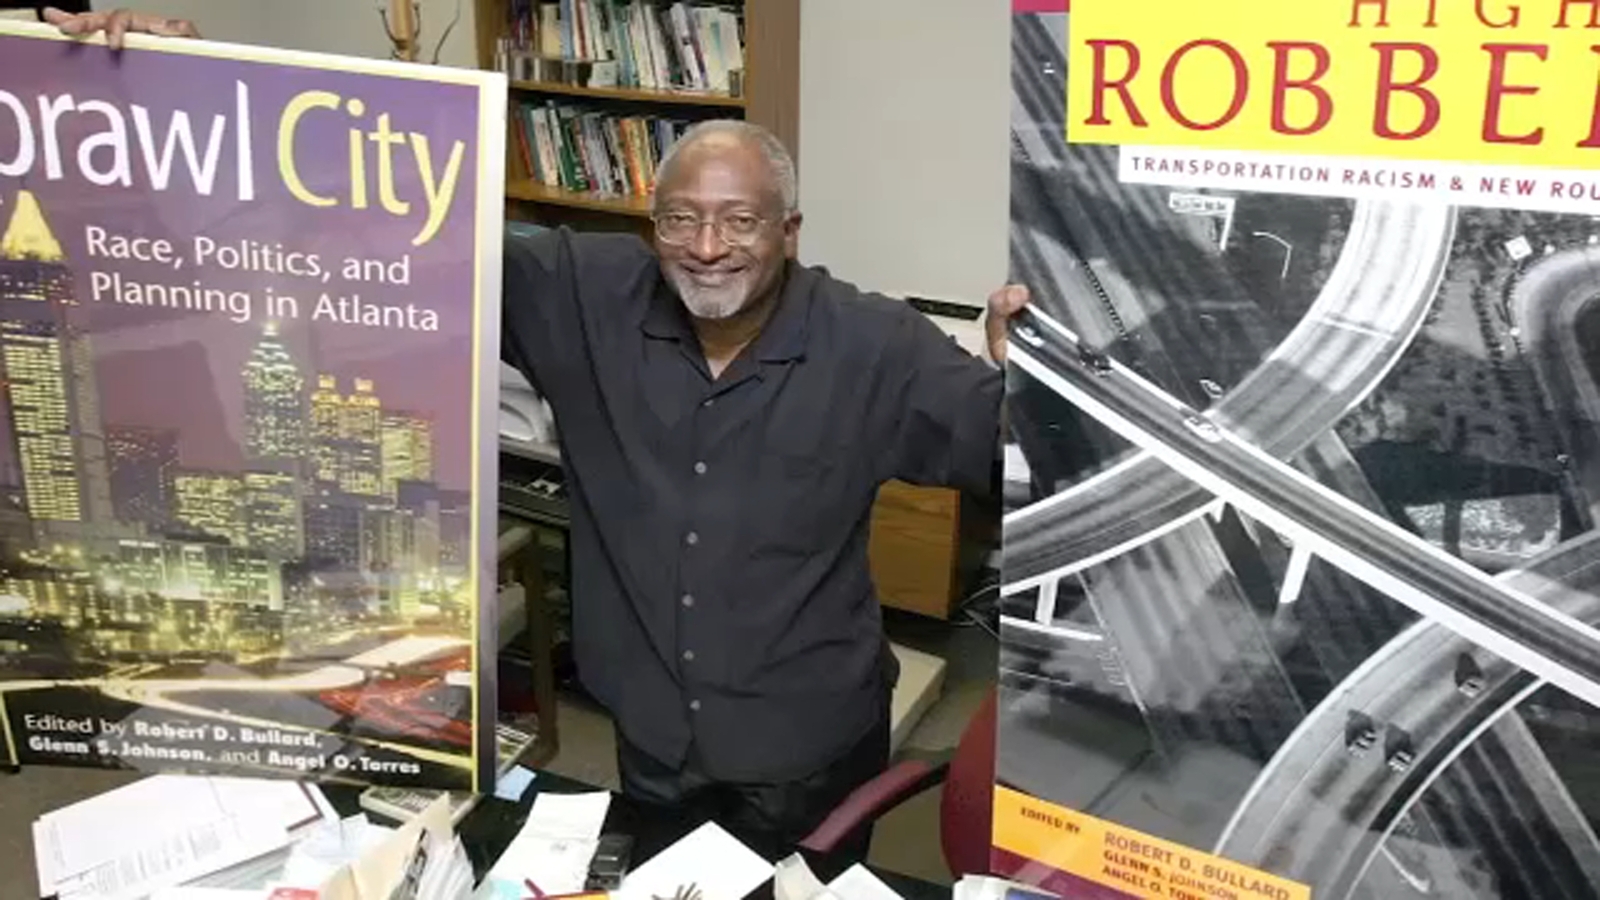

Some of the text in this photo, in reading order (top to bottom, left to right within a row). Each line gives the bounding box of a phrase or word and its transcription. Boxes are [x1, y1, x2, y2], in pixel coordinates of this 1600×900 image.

[277, 90, 465, 247] City
[1132, 156, 1330, 182] TRANSPORTATION
[1342, 169, 1436, 189] RACISM
[1450, 175, 1463, 191] &
[1480, 177, 1536, 196] NEW
[86, 225, 410, 285] Race, Politics, and
[91, 271, 439, 331] Planning in Atlanta
[24, 714, 93, 734] Edited
[100, 719, 127, 738] by
[133, 721, 205, 740] Robert
[213, 727, 236, 742] D.
[29, 736, 90, 754] Glenn
[97, 741, 117, 756] S.
[221, 749, 260, 764] and
[267, 752, 325, 771] Angel
[333, 755, 356, 771] O.
[358, 757, 421, 775] Torres
[1101, 865, 1146, 888] ANGEL
[1103, 850, 1238, 900] GLENN S. JOHNSON
[1104, 831, 1290, 900] ROBERT D. BULLARD
